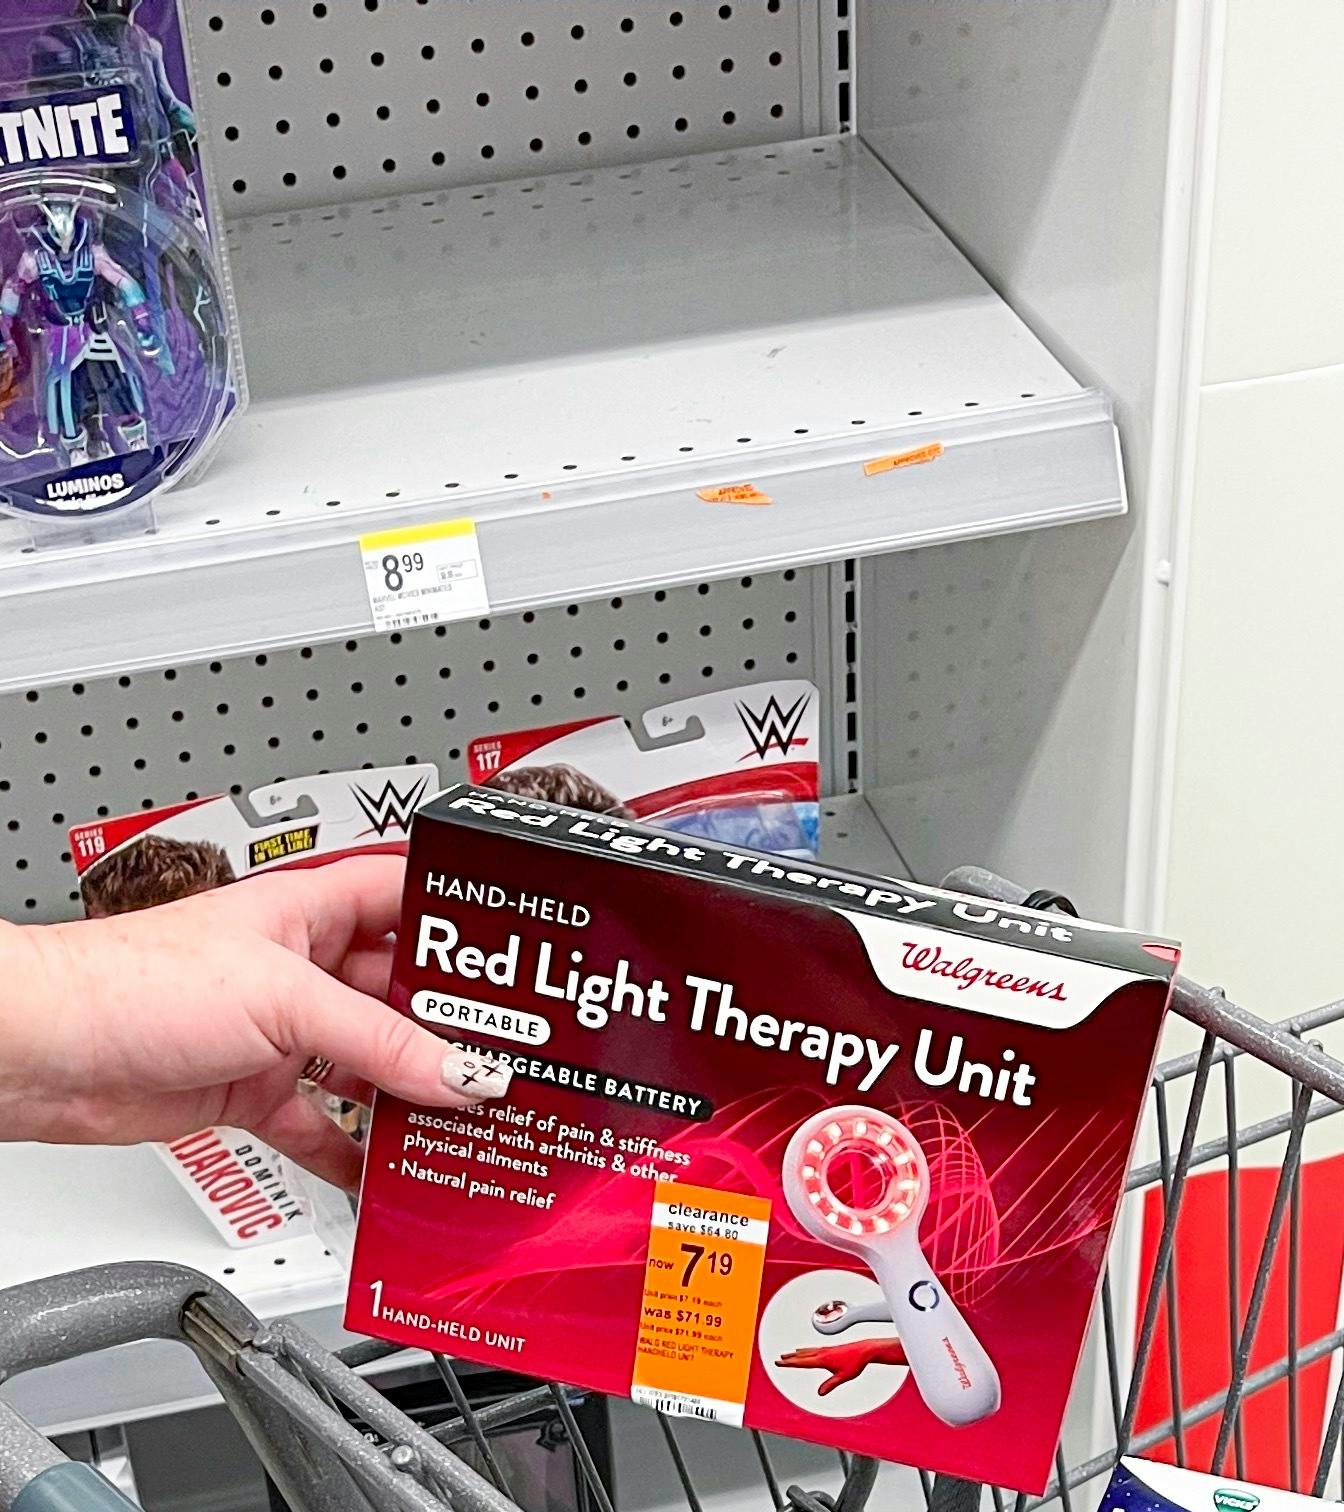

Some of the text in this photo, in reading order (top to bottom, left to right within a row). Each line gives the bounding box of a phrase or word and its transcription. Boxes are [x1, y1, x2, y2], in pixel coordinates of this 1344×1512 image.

[46, 473, 125, 499] LUMINOS
[476, 751, 502, 771] 117
[74, 826, 104, 842] SERIES
[78, 836, 105, 857] 119
[448, 796, 1073, 943] Red Light Therapy Unit
[426, 872, 591, 927] HAND-HELD
[902, 941, 1068, 1002] Walgreens
[415, 914, 1037, 1106] Red Light Therapy Unit
[425, 998, 539, 1039] PORTABLE
[603, 1077, 703, 1117] BATTERY
[403, 1134, 549, 1178] physical ailments
[408, 1112, 678, 1184] associated with arthritis & other
[488, 1104, 535, 1128] relief
[537, 1114, 557, 1132] of
[558, 1121, 594, 1144] pain
[600, 1128, 615, 1147] &
[618, 1136, 691, 1166] stiffness
[234, 1144, 304, 1222] DOMINIK
[401, 1159, 557, 1211] Natural pain relief
[668, 1202, 749, 1227] clearance
[668, 1220, 739, 1241] save $64.80
[649, 1257, 675, 1271] now
[369, 1279, 526, 1353] 1 HAND-HELD UNIT
[644, 1306, 723, 1328] was $71.99
